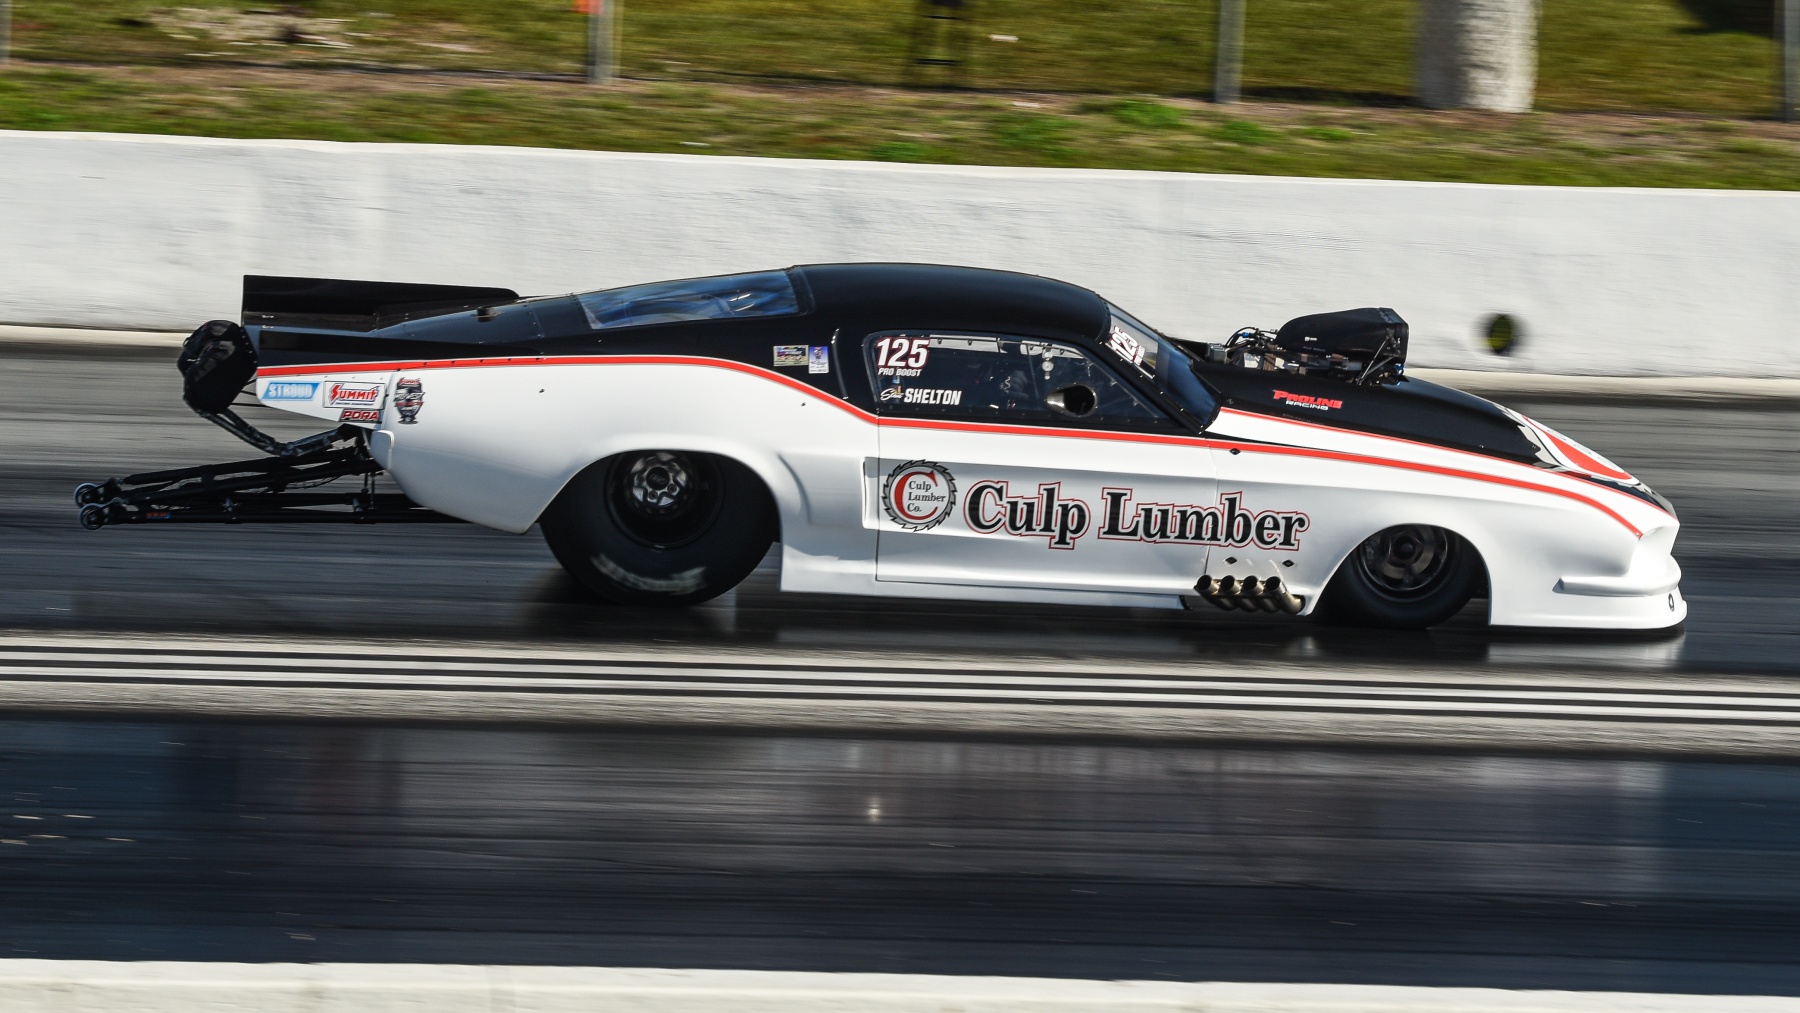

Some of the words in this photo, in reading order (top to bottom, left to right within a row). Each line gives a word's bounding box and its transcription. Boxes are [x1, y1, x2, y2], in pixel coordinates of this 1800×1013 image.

[876, 337, 930, 368] 125
[878, 368, 895, 376] PRO
[895, 369, 923, 377] BOOST
[268, 384, 313, 398] STROUD
[903, 388, 962, 405] SHELTON
[1273, 389, 1343, 409] PROLINE
[1285, 400, 1329, 411] RACING
[908, 481, 932, 492] Culp
[908, 492, 947, 502] Lumber
[907, 503, 922, 512] Co.
[966, 481, 1089, 547] Culp
[1100, 491, 1308, 549] Lumber
